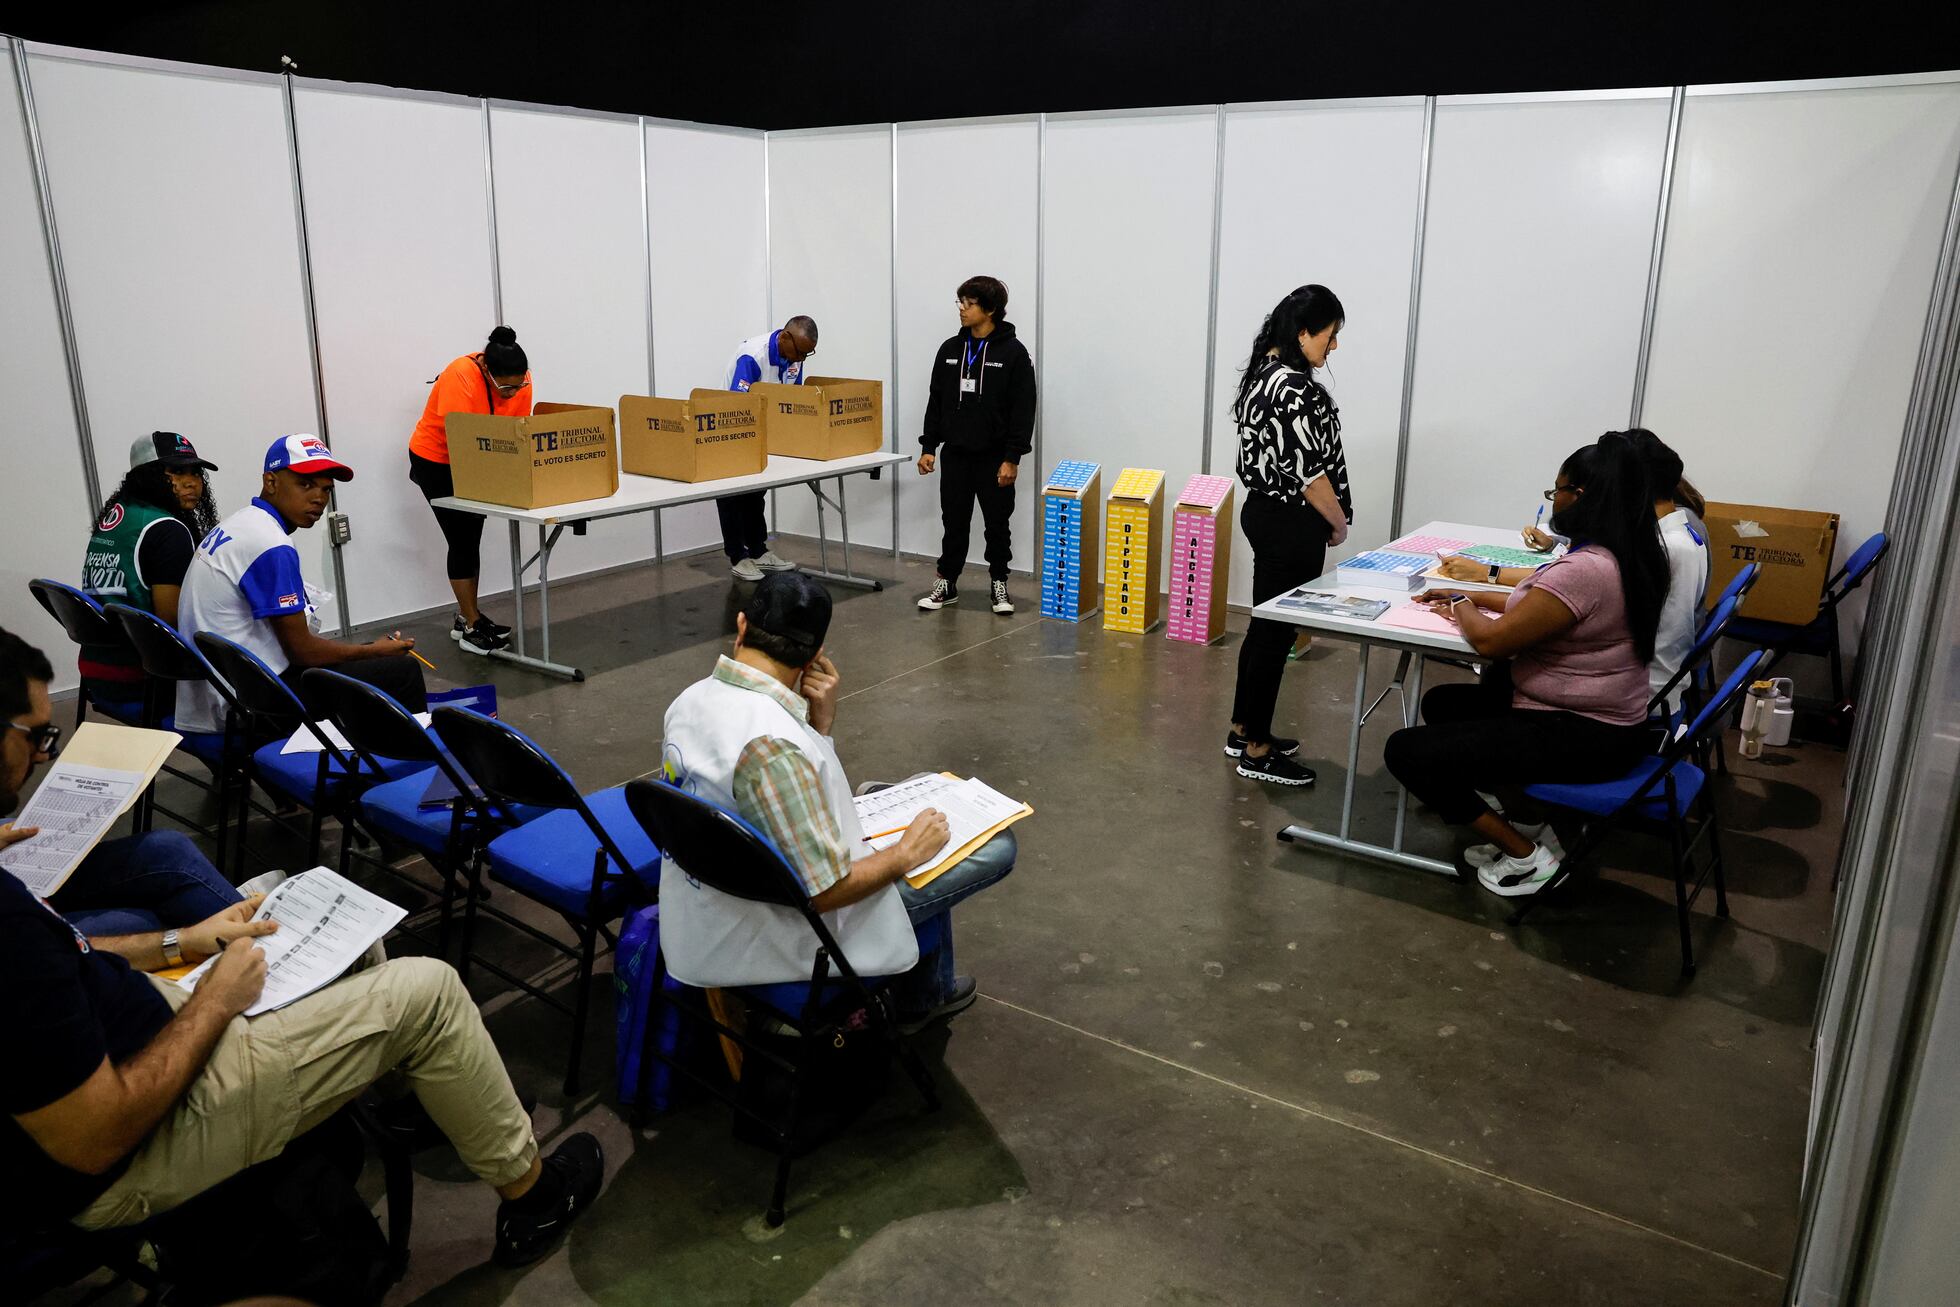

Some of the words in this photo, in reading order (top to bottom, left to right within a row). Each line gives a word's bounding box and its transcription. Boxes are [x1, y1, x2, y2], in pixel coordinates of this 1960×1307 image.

[778, 403, 792, 414] TE
[646, 417, 660, 431] TE
[694, 413, 716, 432] TE
[718, 410, 752, 419] TRIBUNAL
[718, 416, 756, 426] ELECTORAL
[476, 437, 492, 451] TE
[532, 431, 558, 453] TE
[560, 426, 602, 438] TRIBUNAL
[560, 433, 607, 446] ELECTORAL
[704, 435, 720, 443] VOTO
[729, 431, 756, 440] SECRETO
[533, 459, 543, 467] EL
[544, 456, 563, 465] VOTO
[564, 454, 574, 463] ES
[575, 450, 606, 461] SECRETO
[201, 527, 233, 556] BY
[1056, 503, 1068, 614] PRESIDENTE
[1731, 544, 1756, 561] TE
[1761, 548, 1801, 558] TRIBUNAL
[1759, 554, 1805, 565] ELECTORAL
[1120, 524, 1131, 615] DIPUTADO
[1185, 538, 1198, 618] ALCALDE
